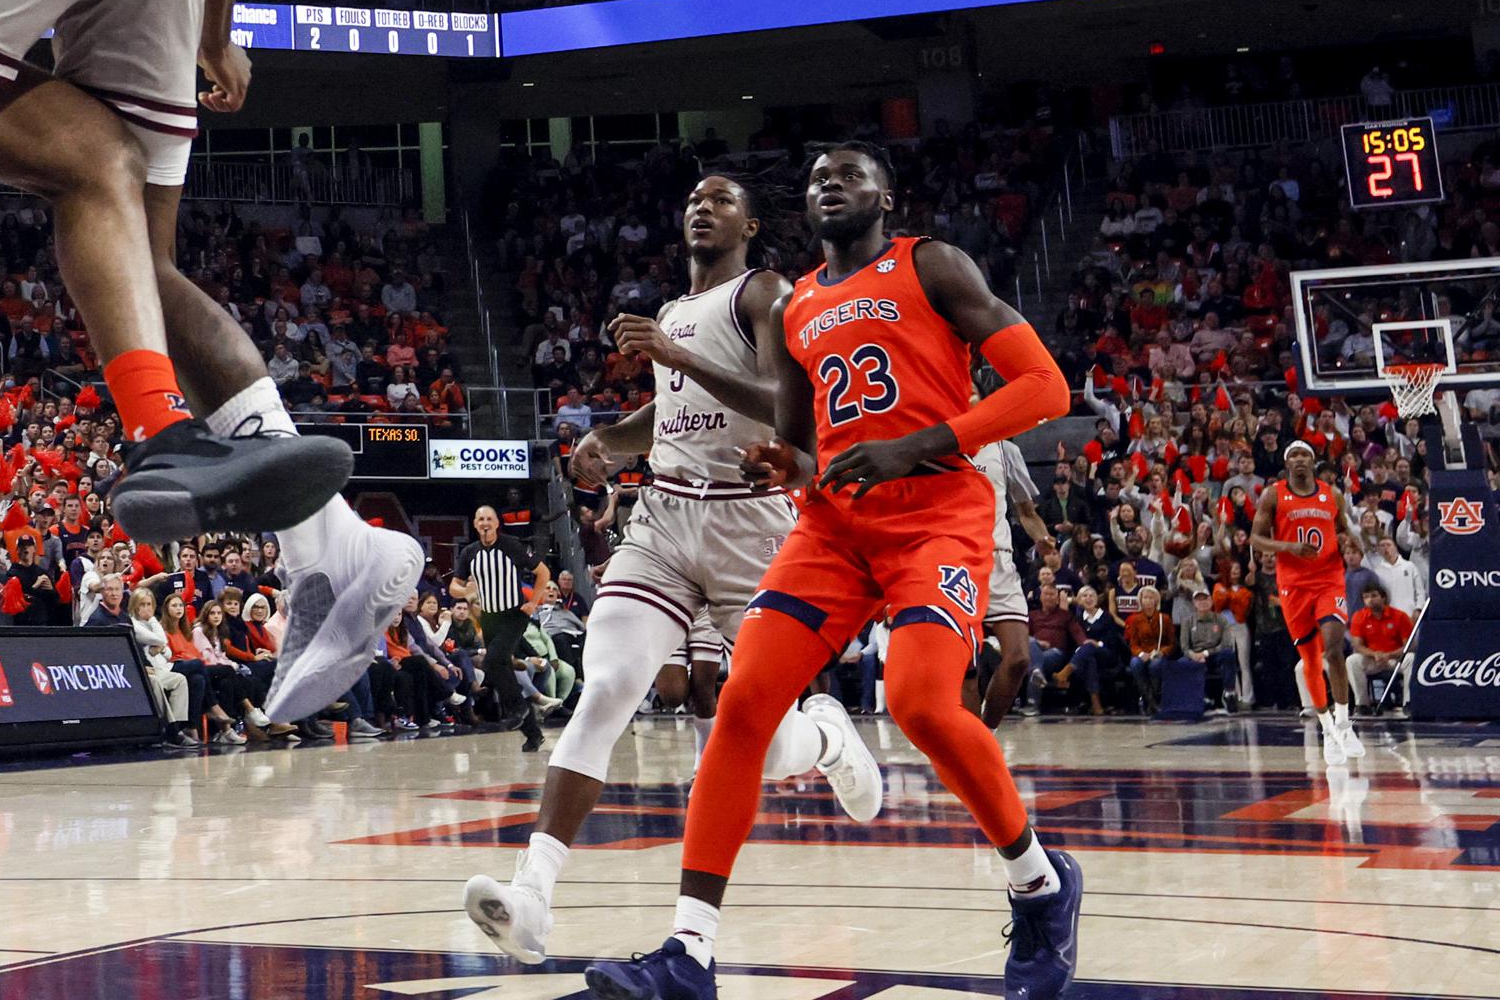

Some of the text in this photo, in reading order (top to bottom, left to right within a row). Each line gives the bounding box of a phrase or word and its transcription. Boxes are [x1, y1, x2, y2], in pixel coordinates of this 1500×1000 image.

[233, 4, 278, 26] Chance
[306, 8, 324, 23] PTS
[340, 10, 368, 26] FOULS
[453, 14, 487, 31] BLOCKS
[230, 28, 254, 48] stry
[310, 27, 321, 49] 2
[349, 28, 360, 51] 0
[388, 30, 399, 53] 0
[427, 32, 438, 55] 0
[466, 34, 474, 56] 1
[1363, 127, 1425, 154] 15:05
[1367, 152, 1423, 197] 27
[799, 297, 900, 349] TIGERS
[818, 342, 900, 427] 23
[657, 404, 728, 437] outhern
[368, 428, 403, 442] TEXAS
[459, 448, 527, 463] COOK'S
[460, 463, 527, 471] PEST CONTROL
[1297, 525, 1325, 553] 10
[1459, 570, 1500, 588] PNC
[1417, 651, 1500, 687] Coca-C
